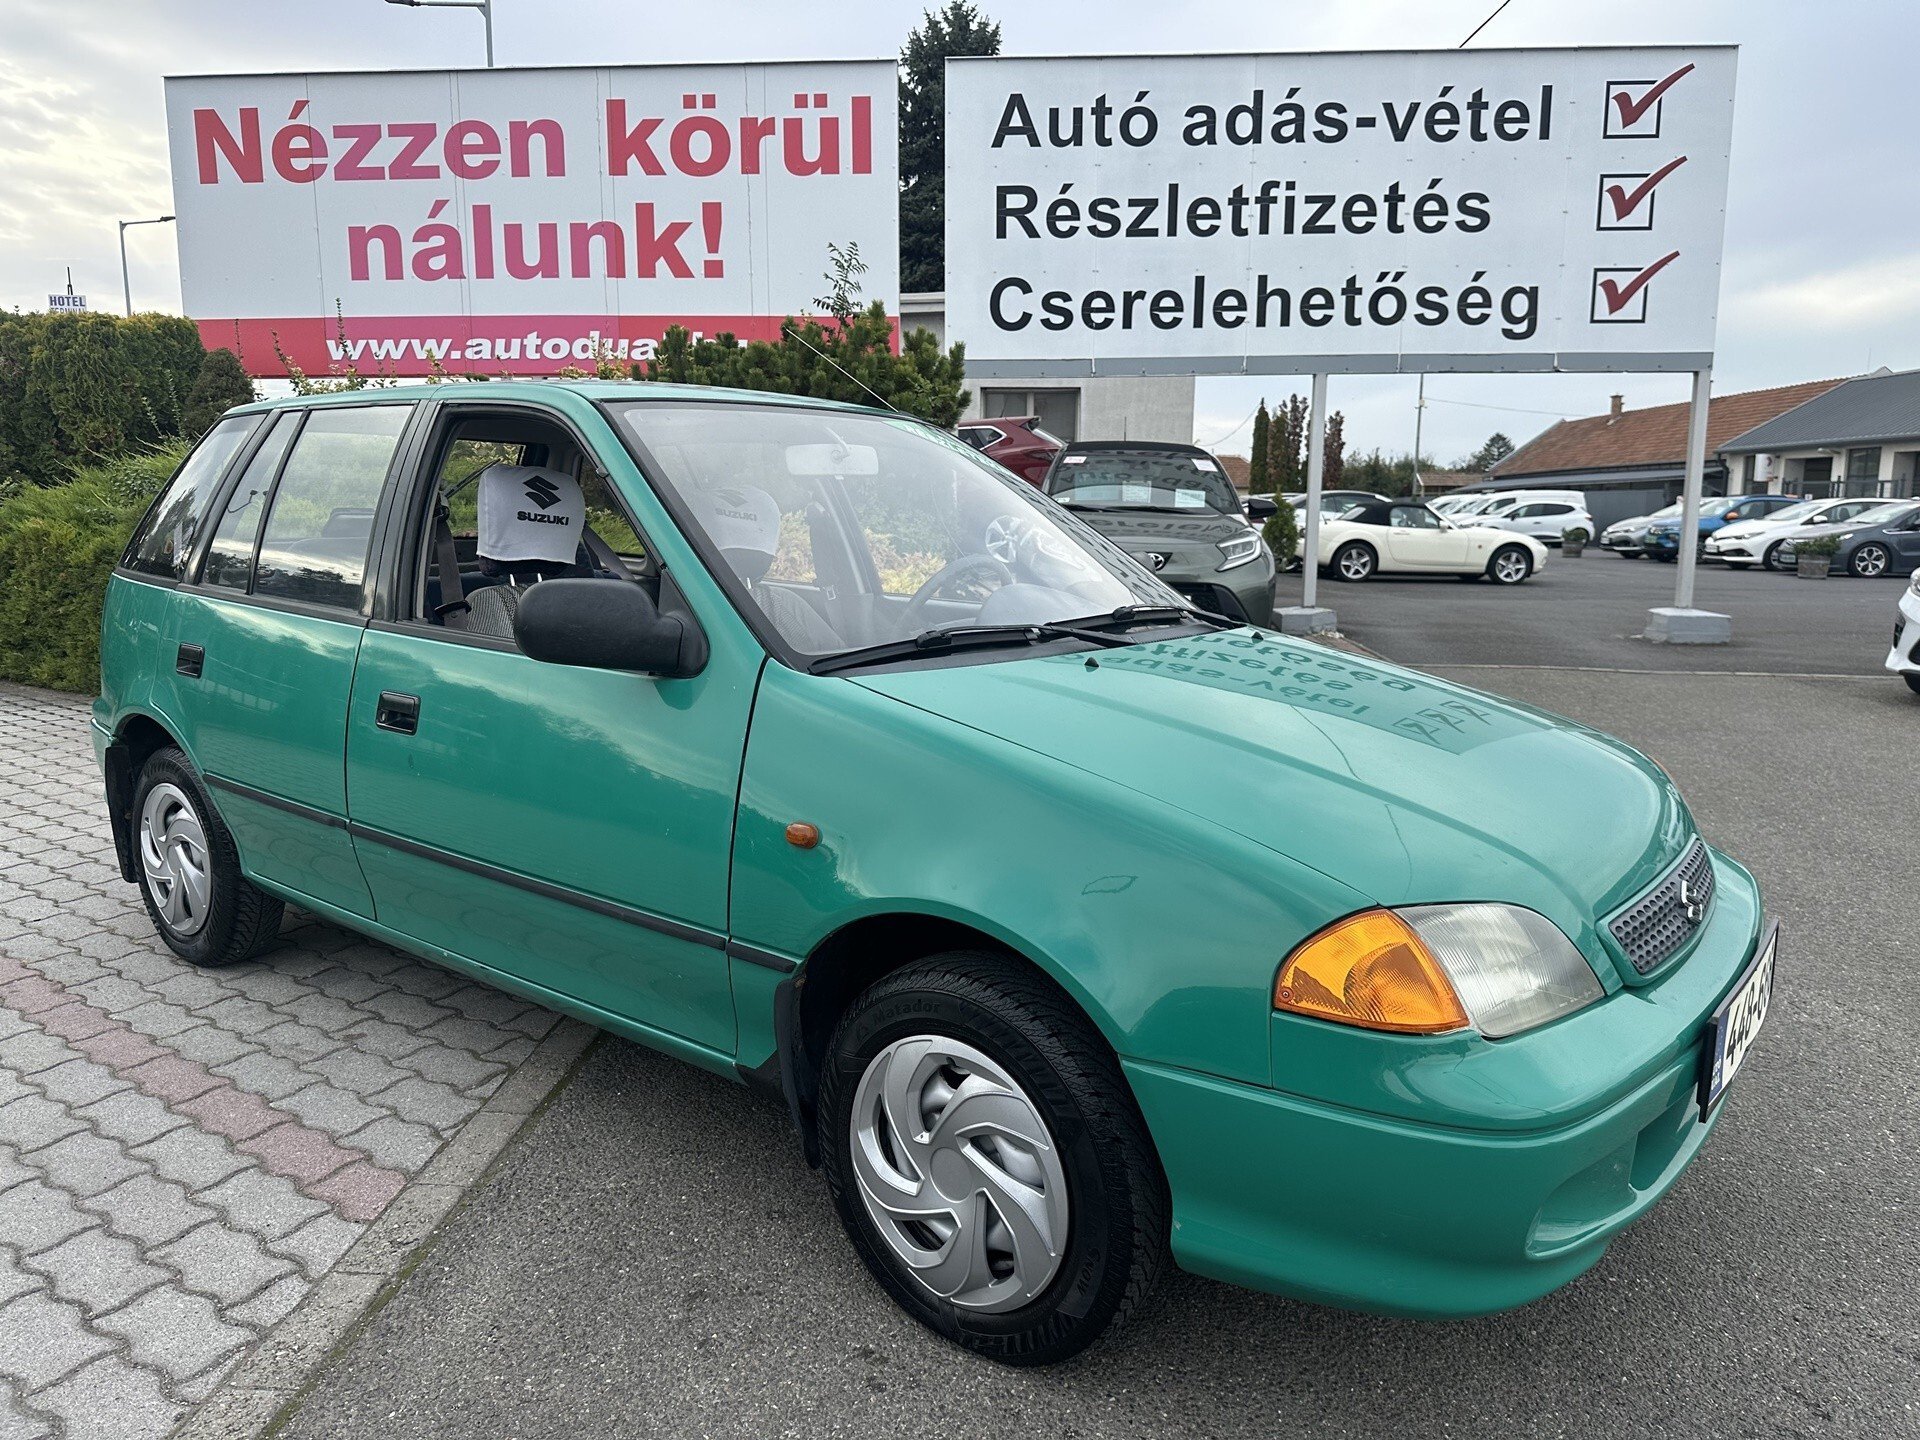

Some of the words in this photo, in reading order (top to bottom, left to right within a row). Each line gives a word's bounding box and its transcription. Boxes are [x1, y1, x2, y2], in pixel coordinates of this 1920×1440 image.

[194, 100, 565, 184] Nézzen
[606, 93, 872, 177] körül
[990, 90, 1158, 148] Autó
[1182, 84, 1553, 147] adás-vétel
[996, 177, 1491, 240] Részletfizetés
[348, 200, 724, 281] nálunk!
[49, 296, 86, 307] HOTEL
[989, 270, 1539, 341] Cserelehetőség
[516, 510, 570, 526] SUZUKI
[715, 505, 758, 522] SUZUKI
